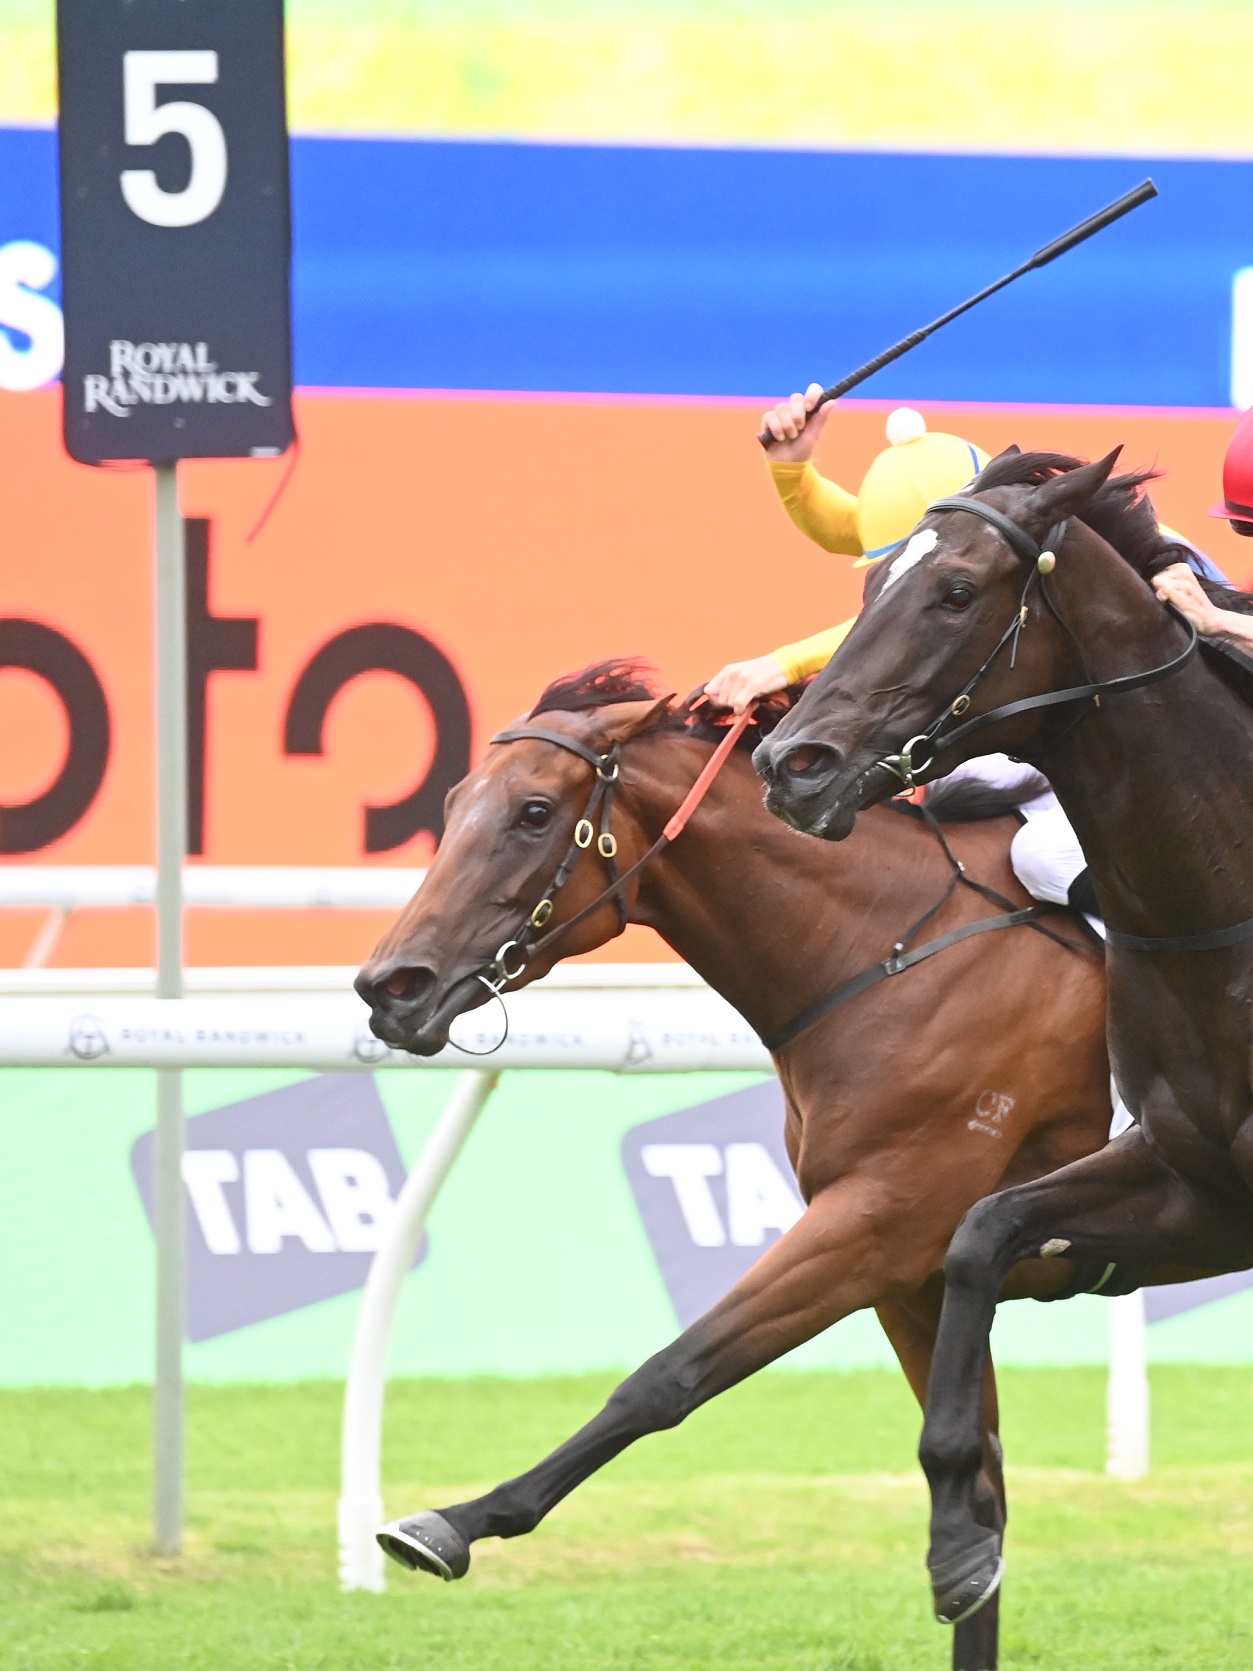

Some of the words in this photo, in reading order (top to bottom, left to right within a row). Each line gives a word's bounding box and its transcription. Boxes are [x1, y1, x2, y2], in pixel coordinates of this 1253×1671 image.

[120, 50, 228, 228] 5
[84, 371, 273, 418] RANDWICK
[109, 339, 218, 382] ROYAL
[180, 1148, 399, 1255] TAB
[641, 1142, 808, 1248] TA
